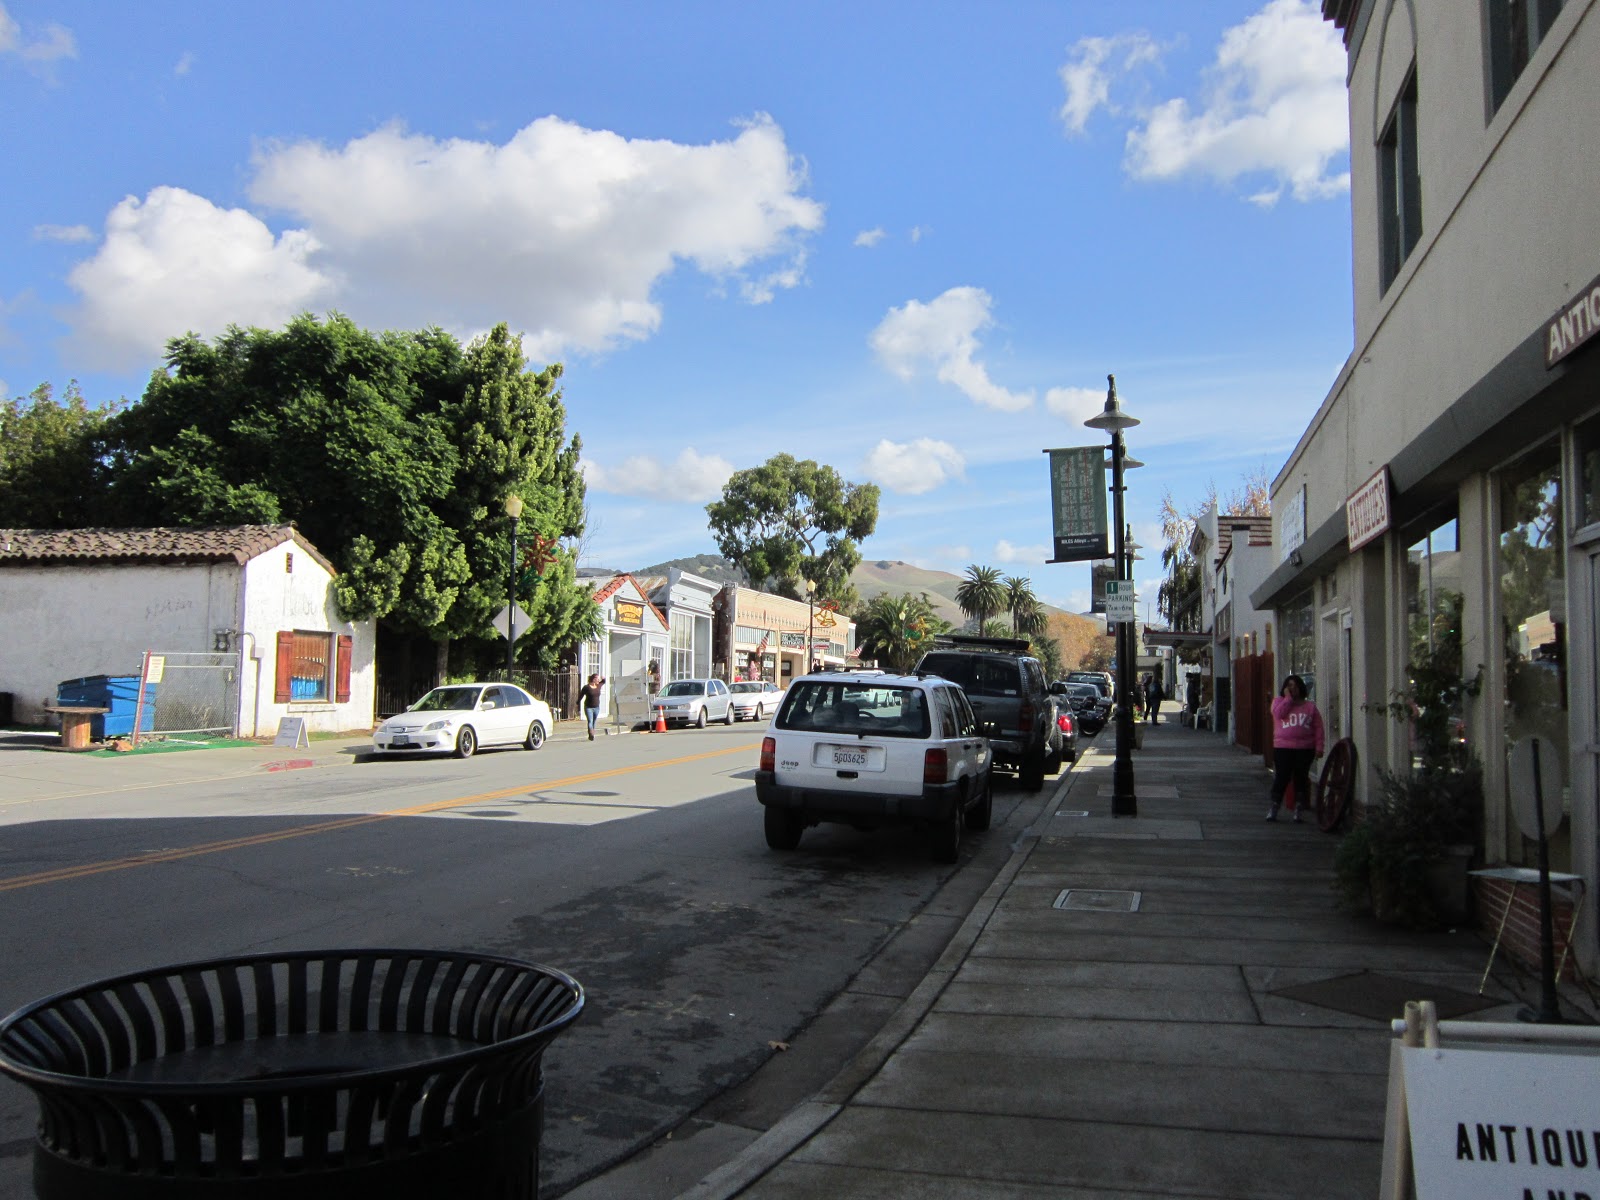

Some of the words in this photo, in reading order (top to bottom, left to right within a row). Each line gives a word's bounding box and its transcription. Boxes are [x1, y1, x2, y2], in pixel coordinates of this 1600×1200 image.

[1350, 478, 1386, 543] ANTIQUES
[1119, 584, 1132, 592] HOUR
[1281, 713, 1313, 729] LOVE
